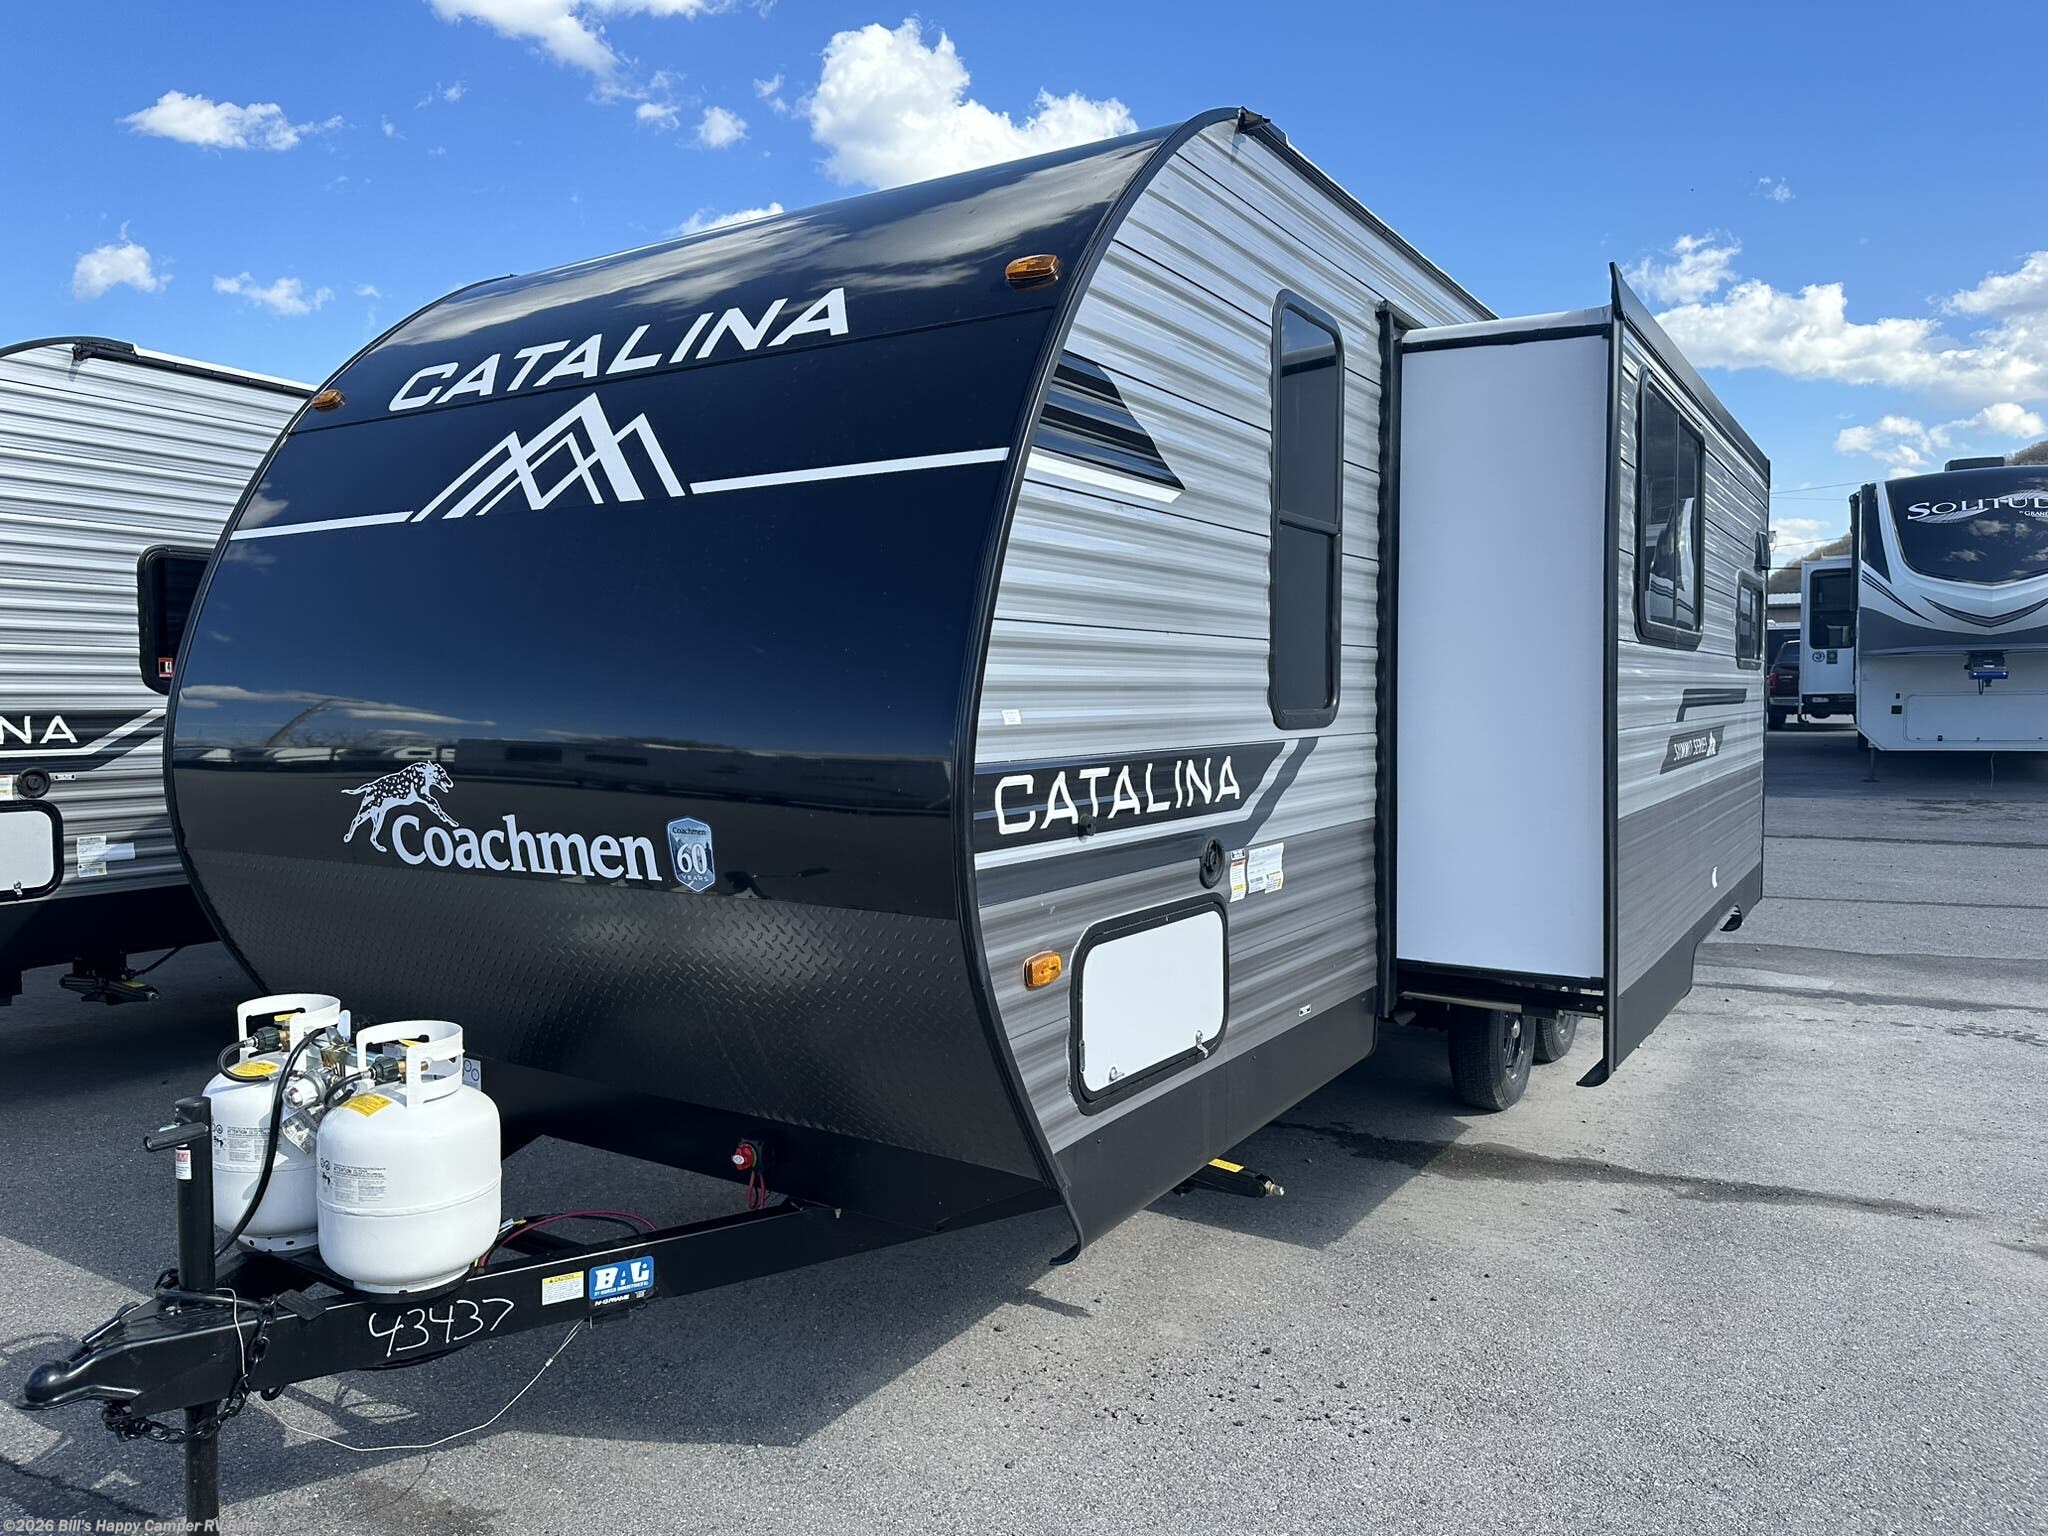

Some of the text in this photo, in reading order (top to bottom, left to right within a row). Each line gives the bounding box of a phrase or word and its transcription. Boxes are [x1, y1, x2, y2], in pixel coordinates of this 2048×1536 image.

[389, 288, 848, 411] CATALINA
[994, 756, 1240, 835] CATALINA
[391, 814, 662, 881] Coachmen
[677, 843, 708, 875] 60
[595, 1261, 650, 1291] BAL
[369, 1298, 515, 1357] 43437
